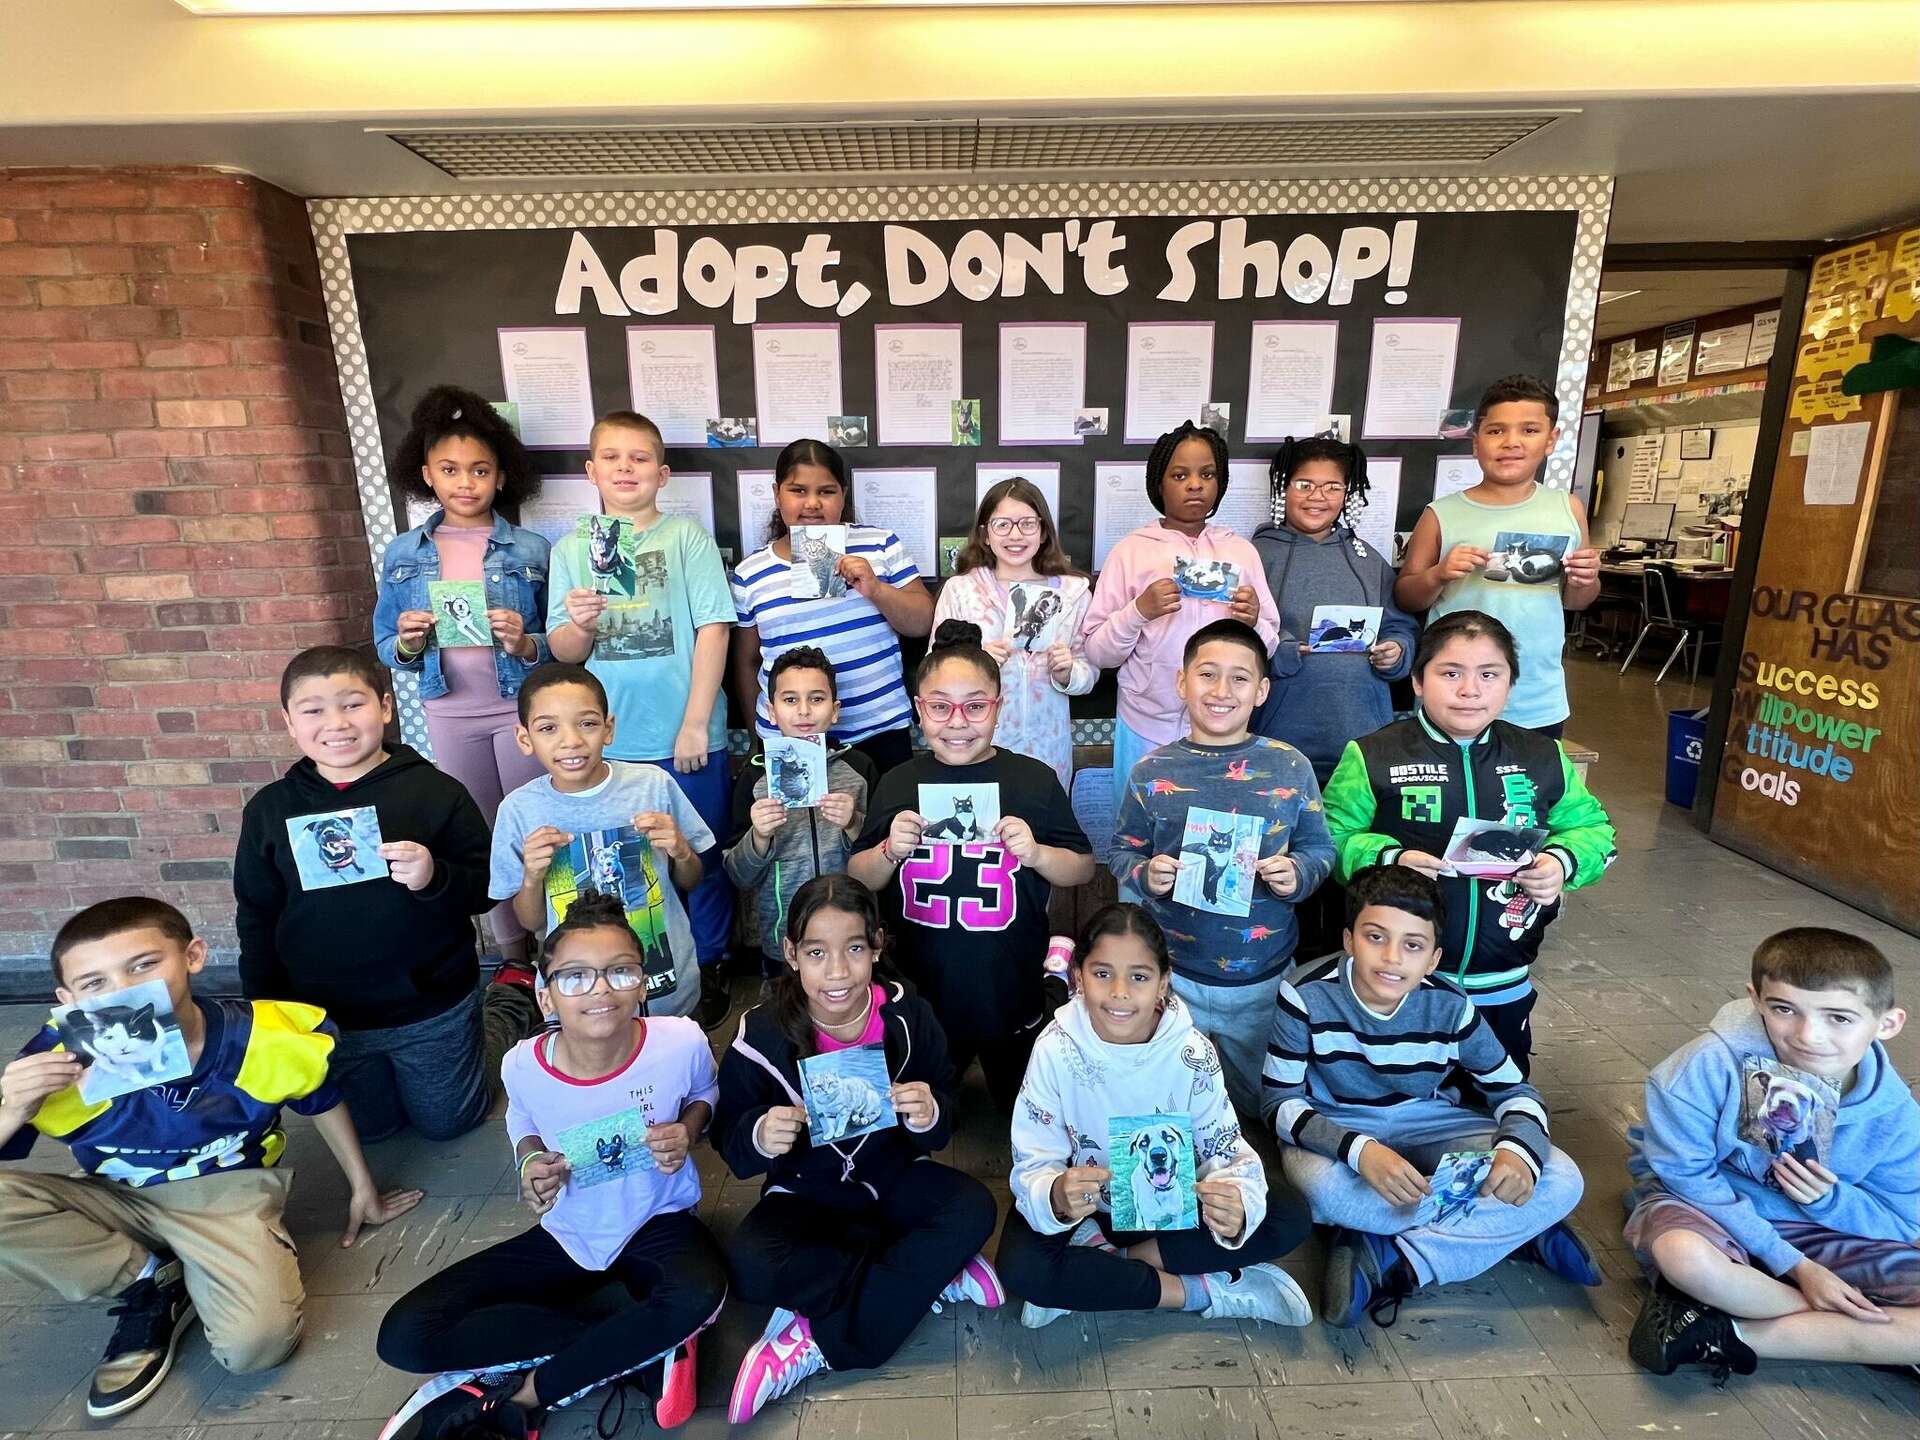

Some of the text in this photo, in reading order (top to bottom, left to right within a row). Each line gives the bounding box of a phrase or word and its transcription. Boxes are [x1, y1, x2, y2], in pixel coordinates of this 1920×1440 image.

[1752, 585, 1818, 624] OUR
[1811, 627, 1892, 670] HAS
[1390, 764, 1448, 777] HOSTILE
[1390, 775, 1449, 784] BEHAVIOUR
[900, 843, 1022, 932] 23
[630, 1085, 653, 1099] THIS
[639, 1102, 655, 1113] IRL
